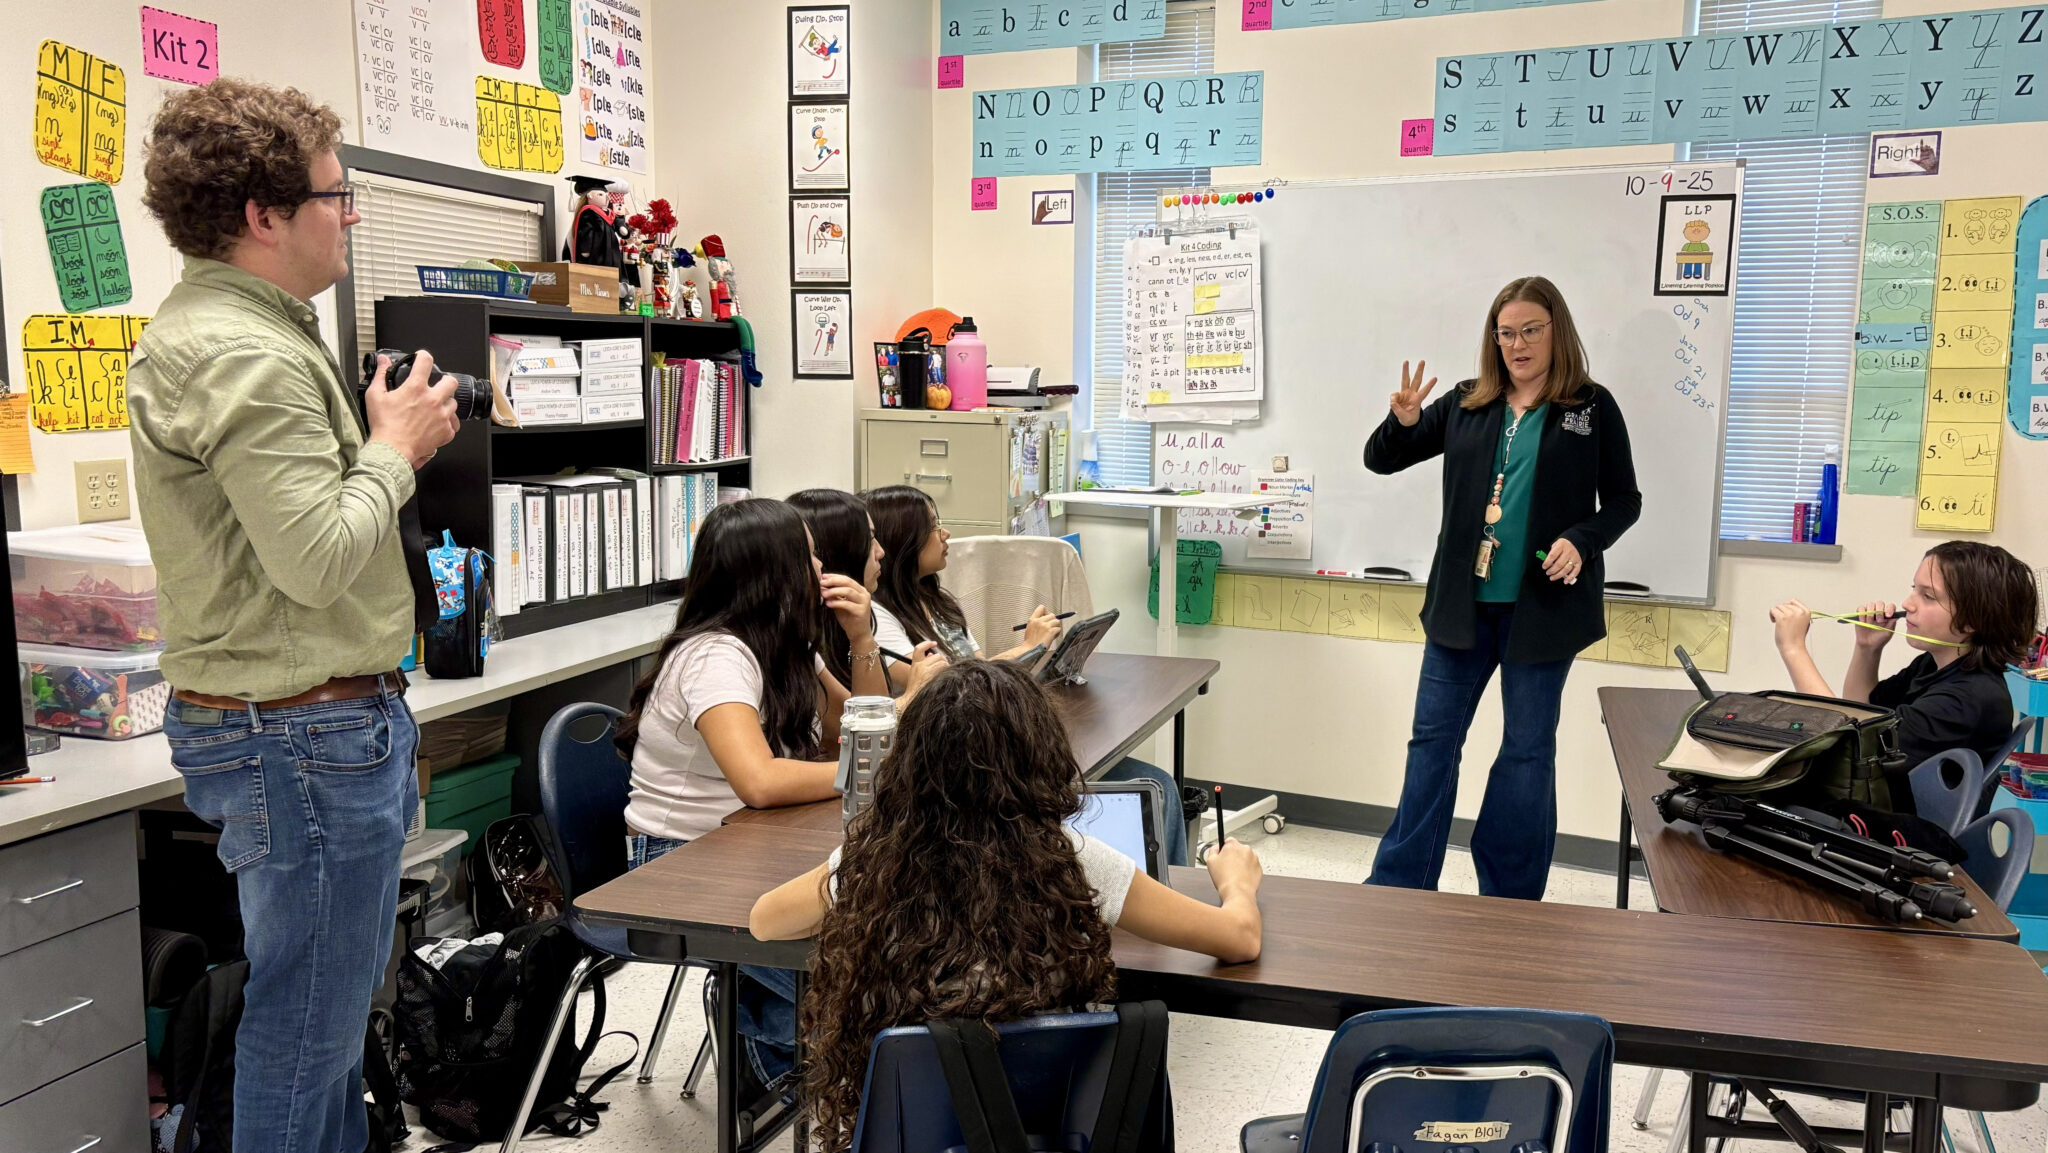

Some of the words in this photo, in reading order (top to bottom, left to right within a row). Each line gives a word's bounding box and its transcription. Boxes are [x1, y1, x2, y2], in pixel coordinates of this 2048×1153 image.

[1248, 0, 1267, 15] 2nd
[795, 16, 814, 24] Swing
[948, 20, 961, 37] a
[1003, 9, 1016, 33] b
[1058, 9, 1070, 27] c
[1113, 0, 1128, 21] d
[1244, 20, 1269, 28] quartile
[153, 29, 188, 65] Kit
[196, 39, 210, 69] 2
[1444, 59, 1463, 89] S
[1514, 54, 1537, 83] T
[1587, 48, 1615, 78] U
[1665, 41, 1693, 72] V
[1743, 34, 1784, 66] W
[1829, 26, 1861, 59] X
[1923, 18, 1953, 51] Y
[2017, 10, 2045, 43] Z
[52, 45, 70, 81] M
[943, 61, 958, 74] 1st
[102, 64, 116, 97] F
[940, 78, 961, 86] quartile
[978, 94, 997, 119] N
[1033, 90, 1051, 116] O
[1089, 86, 1106, 112] P
[1144, 81, 1164, 113] Q
[1206, 78, 1226, 105] R
[1444, 110, 1457, 133] s
[1515, 101, 1528, 128] t
[1587, 104, 1606, 124] u
[1664, 98, 1684, 119] v
[1743, 94, 1770, 114] w
[1829, 88, 1851, 108] x
[1918, 81, 1944, 110] y
[2014, 74, 2035, 96] z
[1408, 124, 1427, 140] 4th
[980, 141, 993, 158] n
[1035, 138, 1047, 155] o
[1089, 135, 1103, 159] p
[1145, 132, 1160, 156] q
[1208, 129, 1220, 146] r
[1404, 145, 1429, 154] quartile
[1877, 146, 1919, 162] Right
[977, 183, 991, 195] 3rd
[1046, 195, 1068, 211] Left
[1882, 206, 1929, 221] S.O.S.
[1946, 223, 1958, 238] 1.
[1197, 242, 1222, 250] Coding
[1941, 276, 1957, 292] 2.
[1680, 335, 1698, 355] Jazz
[1936, 333, 1952, 348] 3.
[1932, 389, 1948, 404] 4.
[64, 411, 80, 425] kit
[1564, 412, 1590, 422] GRAND
[1565, 417, 1590, 428] PRAIRIE
[1926, 445, 1942, 460] 5.
[1920, 497, 1935, 511] 6.
[1426, 1125, 1468, 1142] Fagan
[1475, 1126, 1503, 1138] B104
